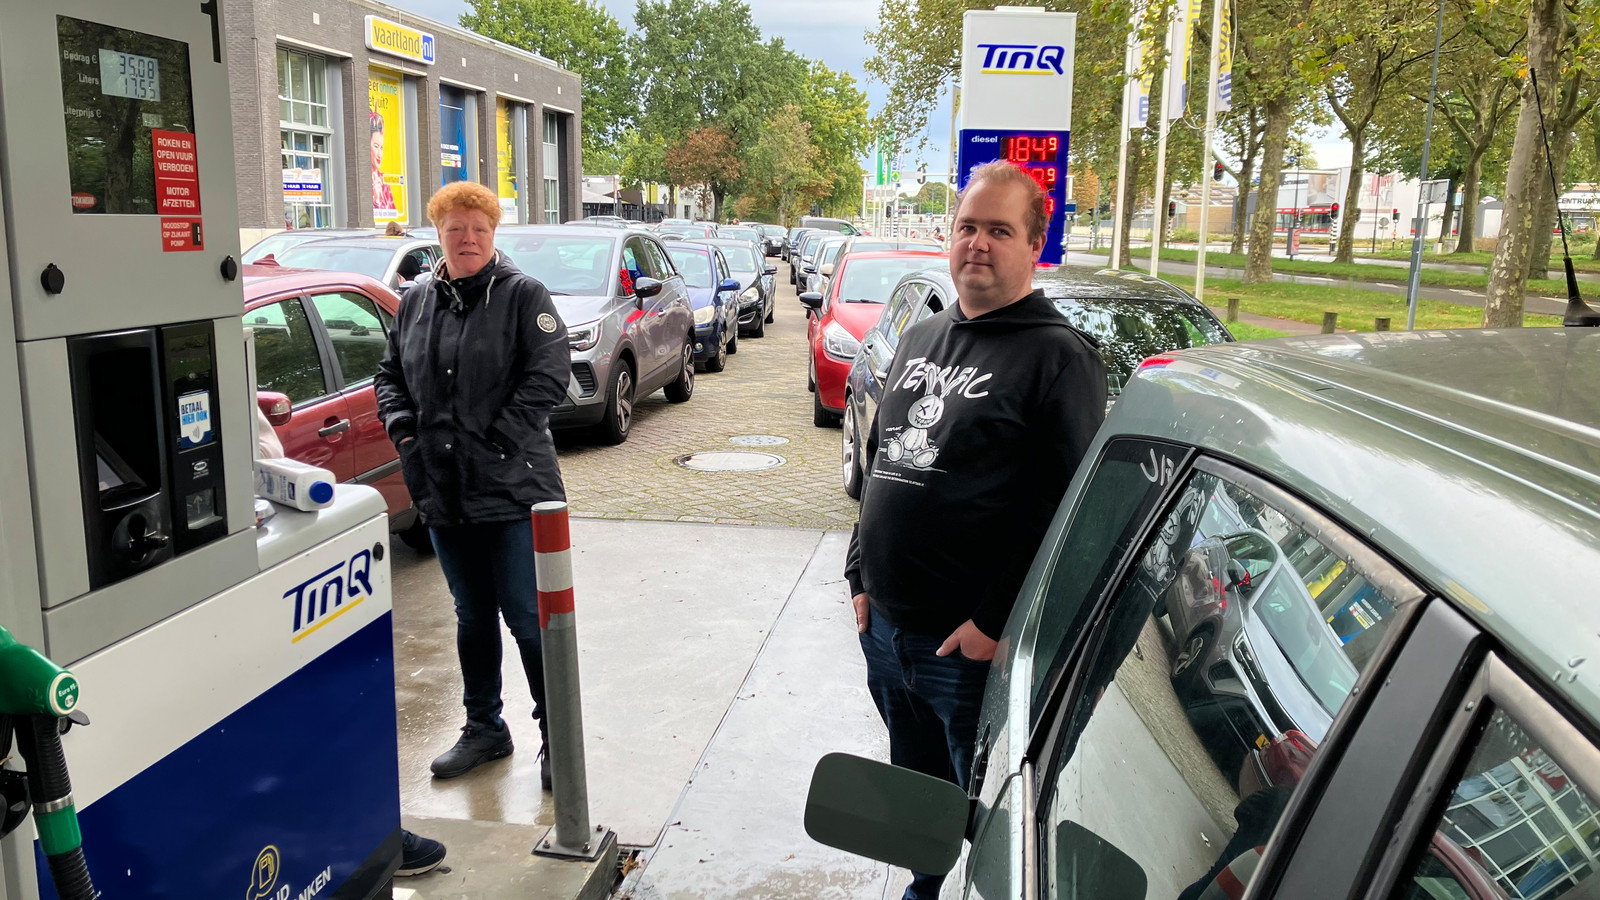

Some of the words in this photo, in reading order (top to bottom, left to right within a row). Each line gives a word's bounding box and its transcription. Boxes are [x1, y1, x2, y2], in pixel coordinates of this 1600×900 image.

[63, 49, 90, 64] Bedrag
[91, 54, 97, 64] €
[78, 73, 99, 85] Liters
[157, 137, 181, 148] ROKEN
[181, 140, 191, 149] EN
[971, 135, 998, 143] diesel
[156, 149, 175, 160] OPEN
[176, 151, 194, 161] VUUR
[158, 162, 194, 173] VERBODEN
[166, 186, 190, 196] MOTOR
[162, 198, 196, 208] AFZETTEN
[181, 401, 203, 415] BETAAL
[182, 413, 195, 426] HIER
[196, 410, 208, 422] OOK
[58, 687, 70, 697] Euro
